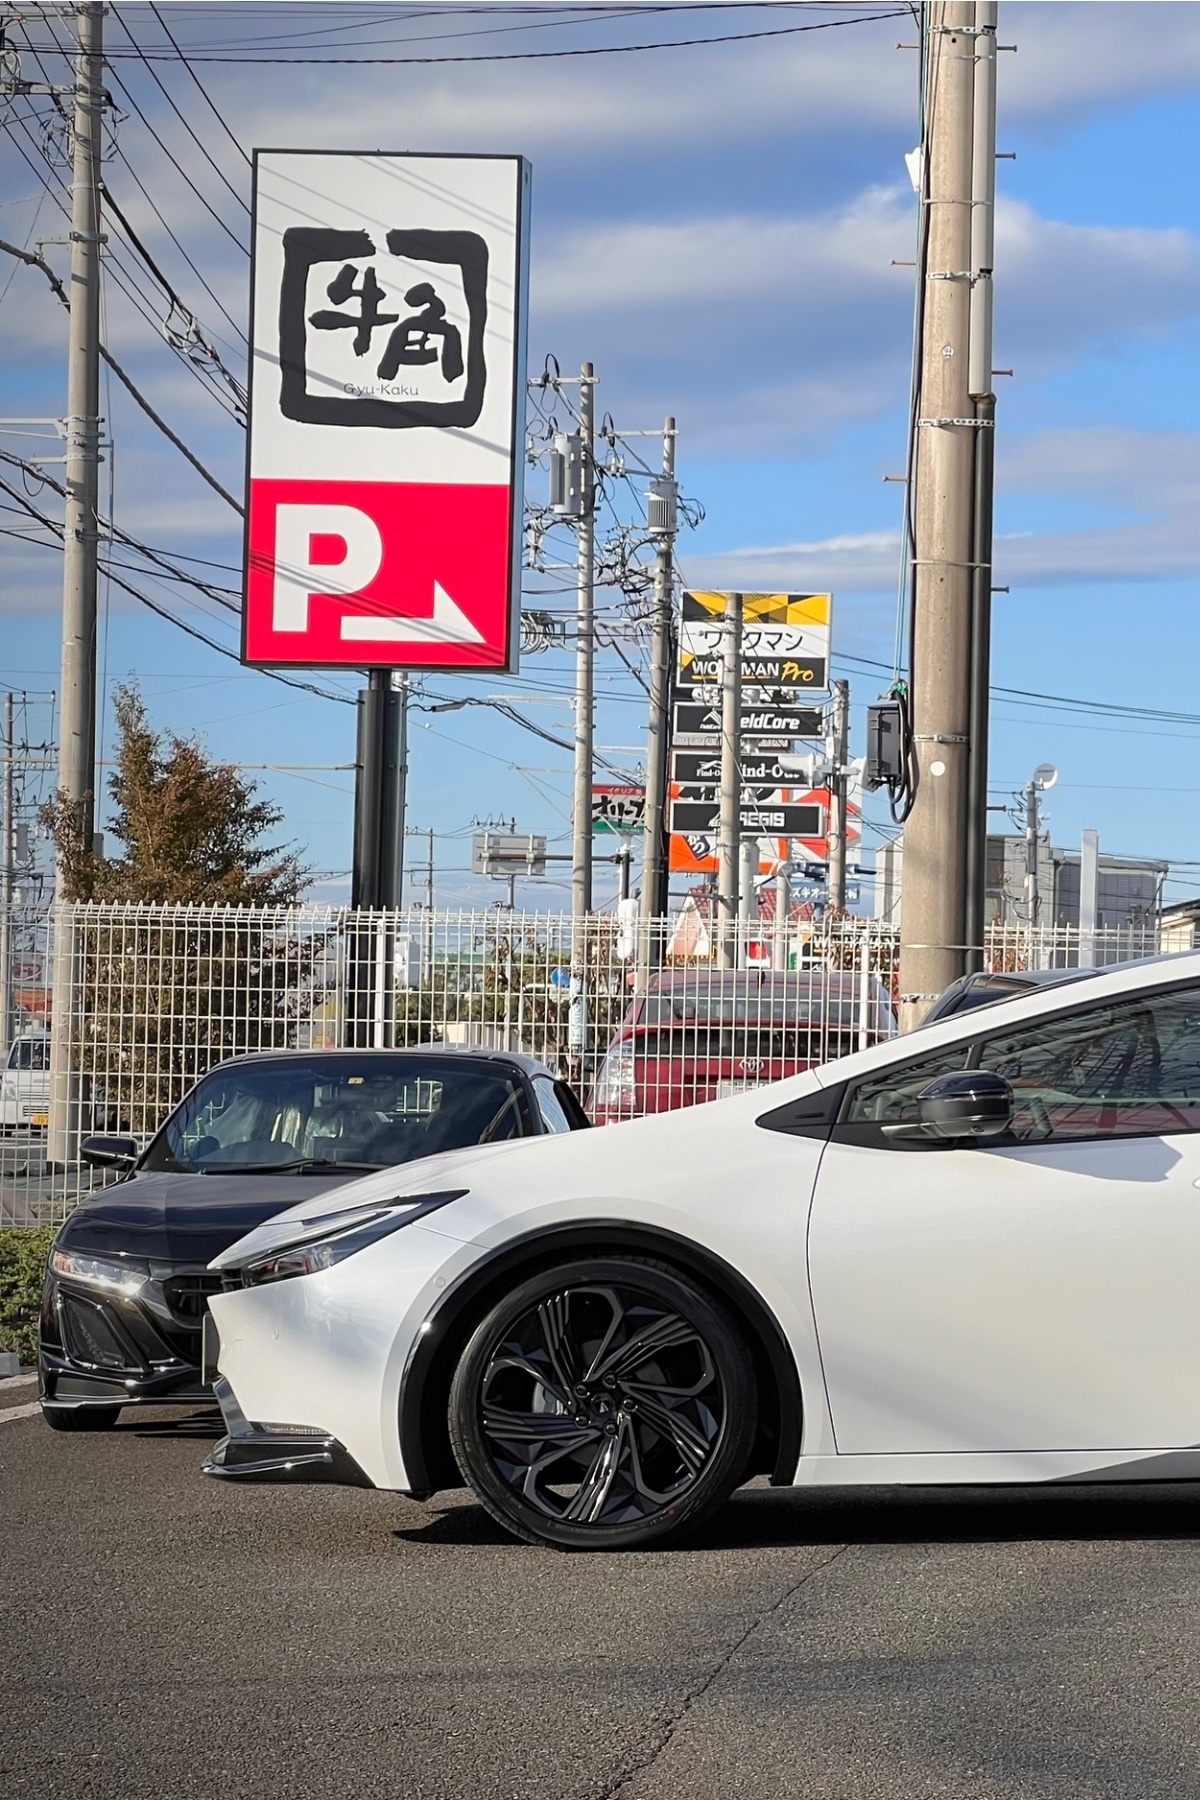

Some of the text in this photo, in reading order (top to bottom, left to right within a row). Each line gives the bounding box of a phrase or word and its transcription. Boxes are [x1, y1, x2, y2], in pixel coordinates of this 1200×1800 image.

[308, 263, 464, 383] 牛角
[343, 382, 419, 397] Gyu-Kaku
[272, 503, 383, 632] P
[704, 630, 804, 652] ワクマン
[691, 660, 815, 682] WOMAN Pro
[740, 712, 800, 730] eldCore
